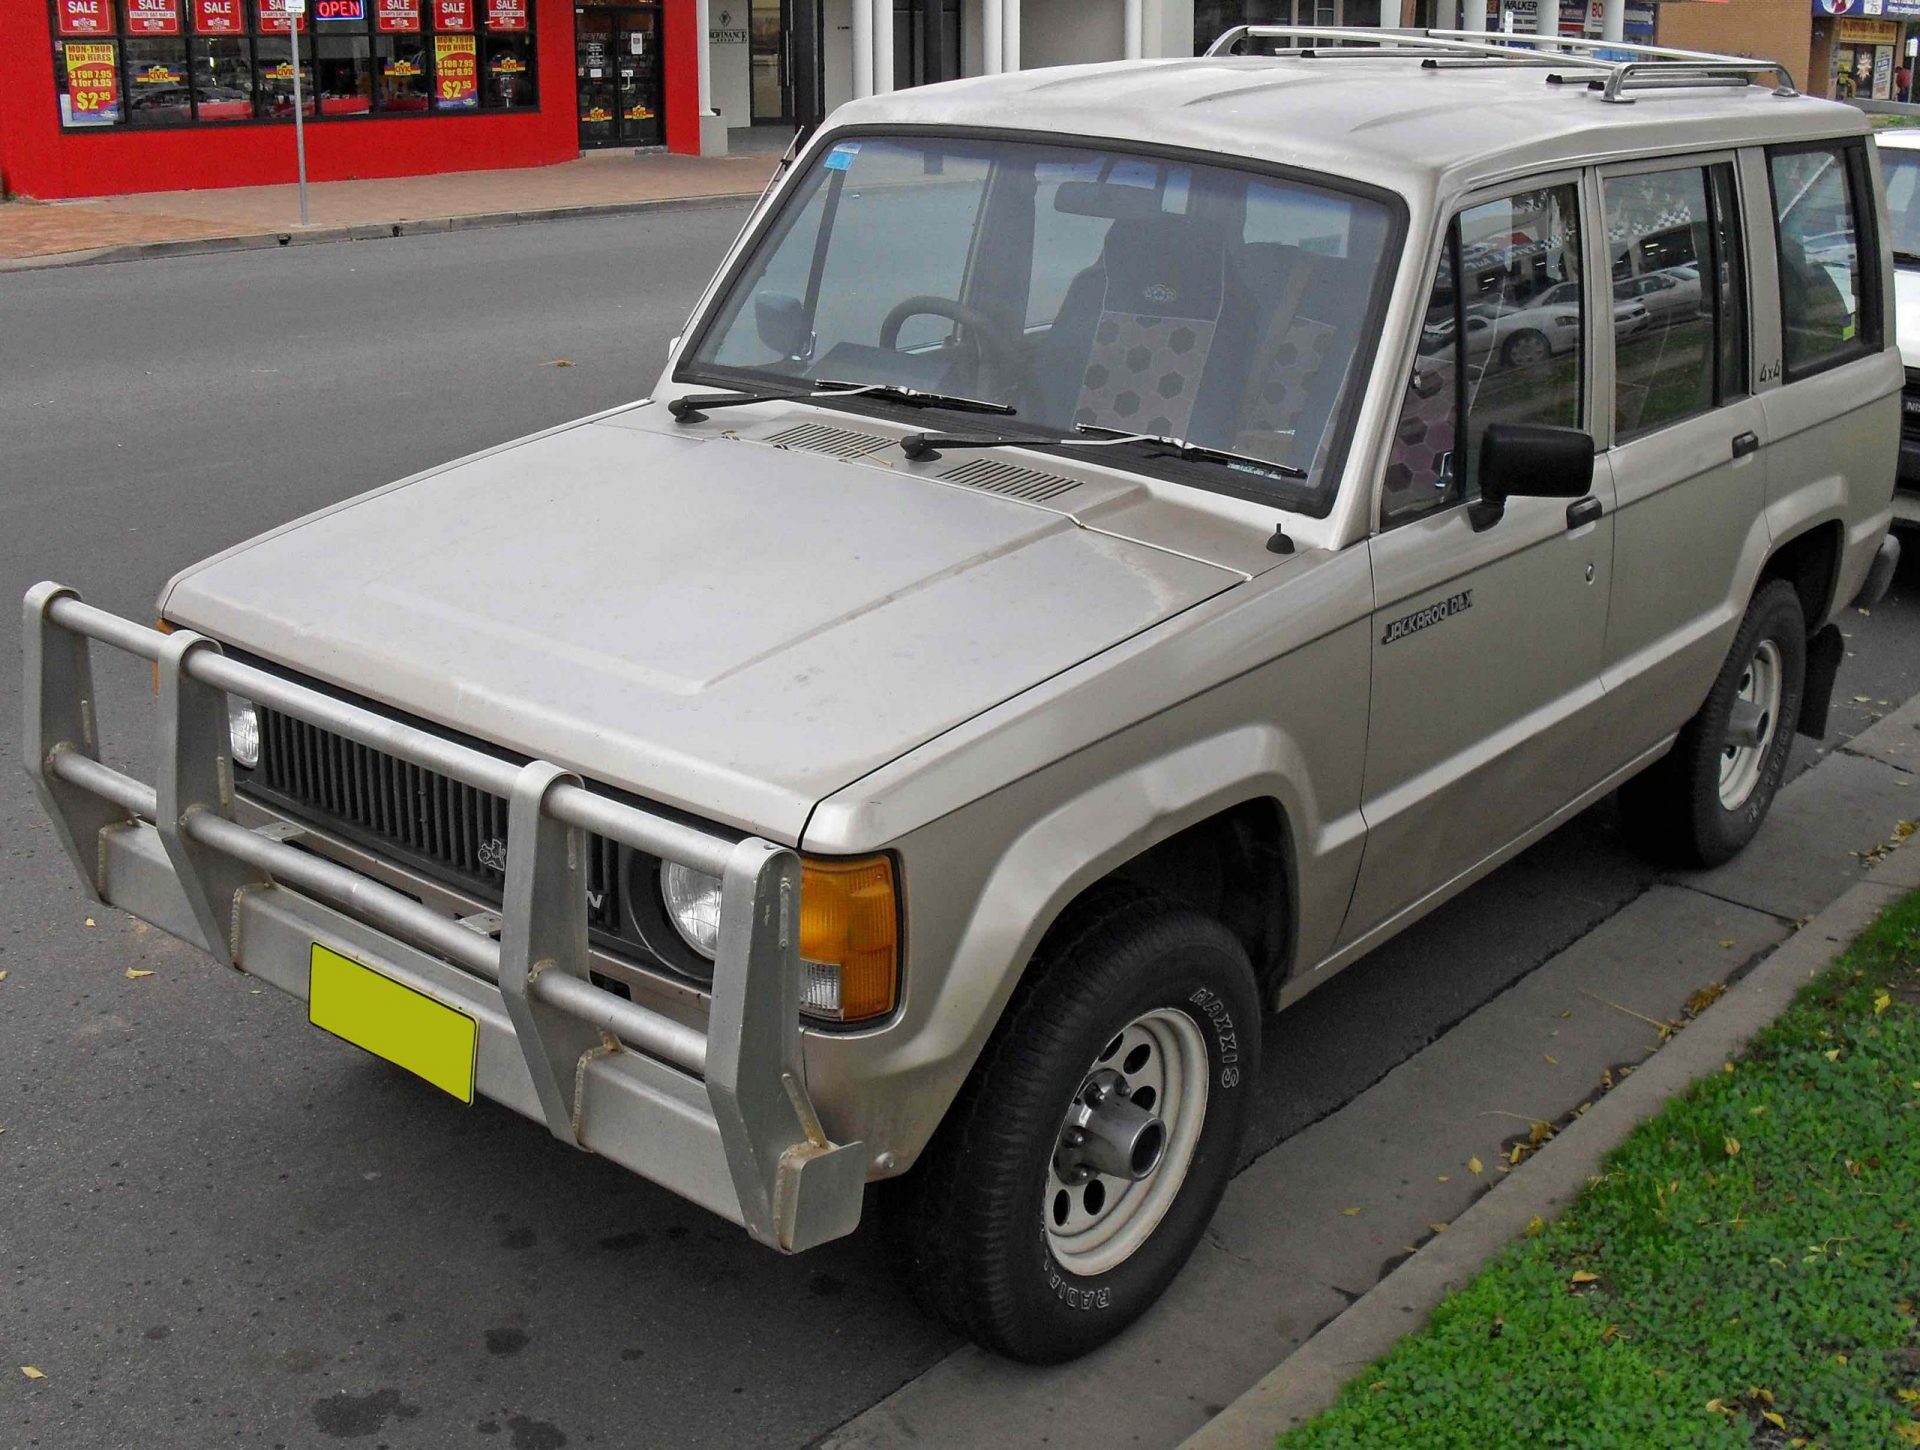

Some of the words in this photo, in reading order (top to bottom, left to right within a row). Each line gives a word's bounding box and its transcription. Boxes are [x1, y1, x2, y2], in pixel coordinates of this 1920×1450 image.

[68, 1, 98, 14] SALE
[138, 0, 166, 10] SALE
[203, 2, 231, 14] SALE
[318, 1, 360, 17] OPEN
[386, 0, 410, 10] SALE
[441, 2, 465, 13] SALE
[496, 0, 518, 10] SALE
[69, 53, 86, 62] DVD
[87, 53, 111, 62] HIRES
[70, 70, 76, 79] 3
[77, 70, 93, 79] FOR
[71, 79, 77, 87] 4
[78, 79, 92, 87] for
[1760, 359, 1780, 383] 4x4
[1382, 601, 1448, 645] JACKAROO
[1189, 988, 1240, 1089] MAXXIS
